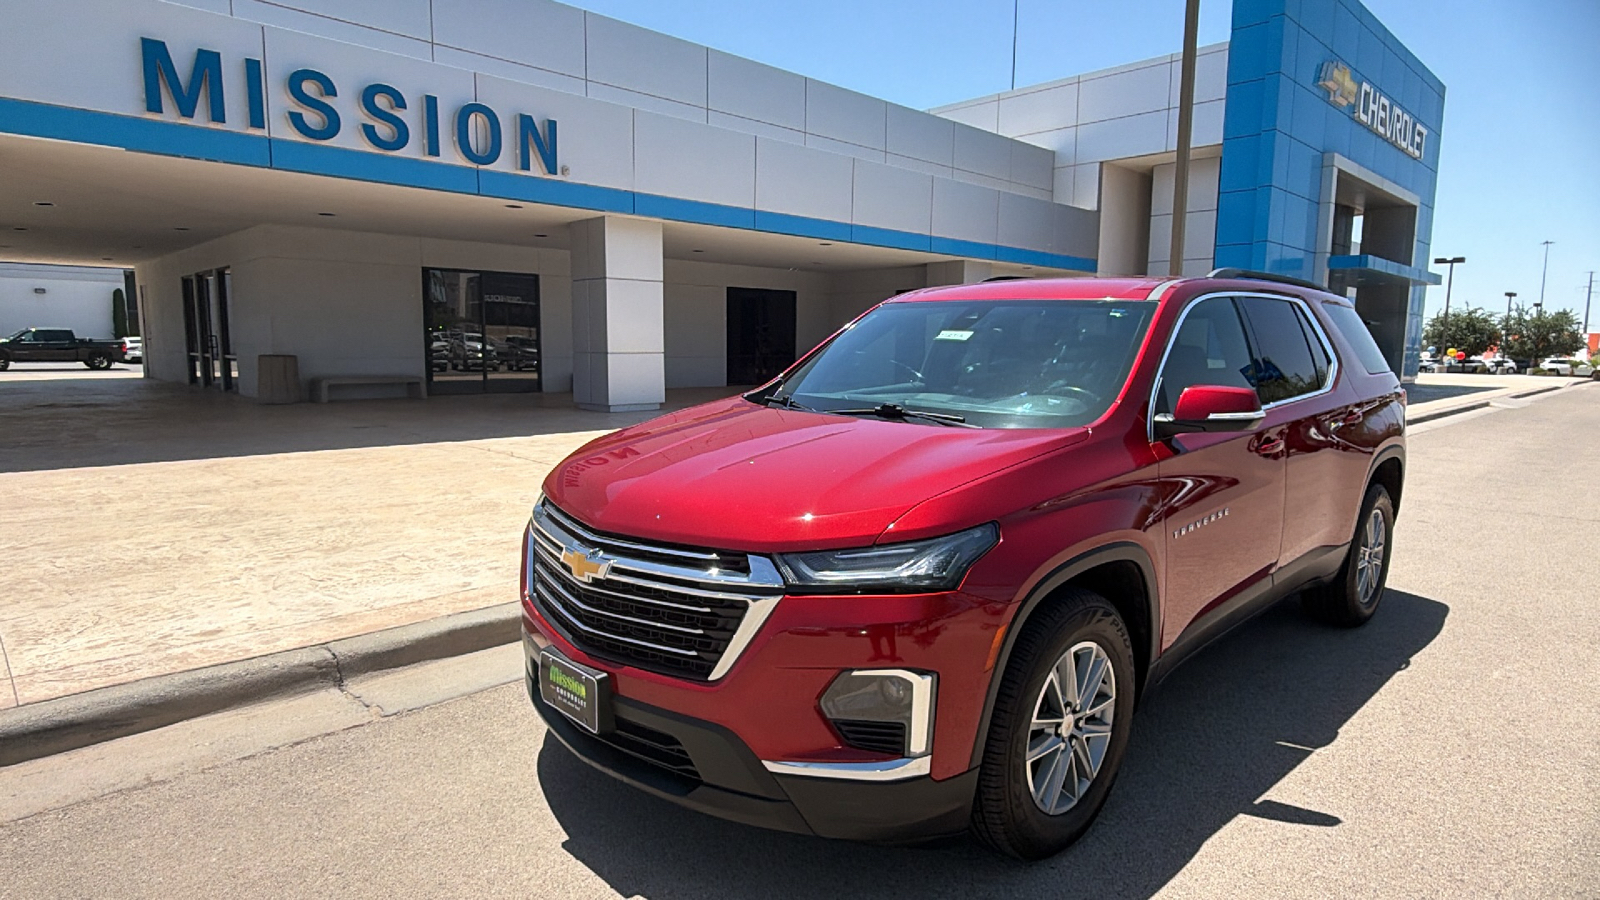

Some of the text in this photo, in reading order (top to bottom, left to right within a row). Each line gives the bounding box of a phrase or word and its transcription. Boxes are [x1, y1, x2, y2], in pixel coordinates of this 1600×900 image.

[140, 36, 558, 176] MISSION
[1360, 81, 1428, 159] CHEVROLET
[1173, 507, 1229, 539] TRAVERSE
